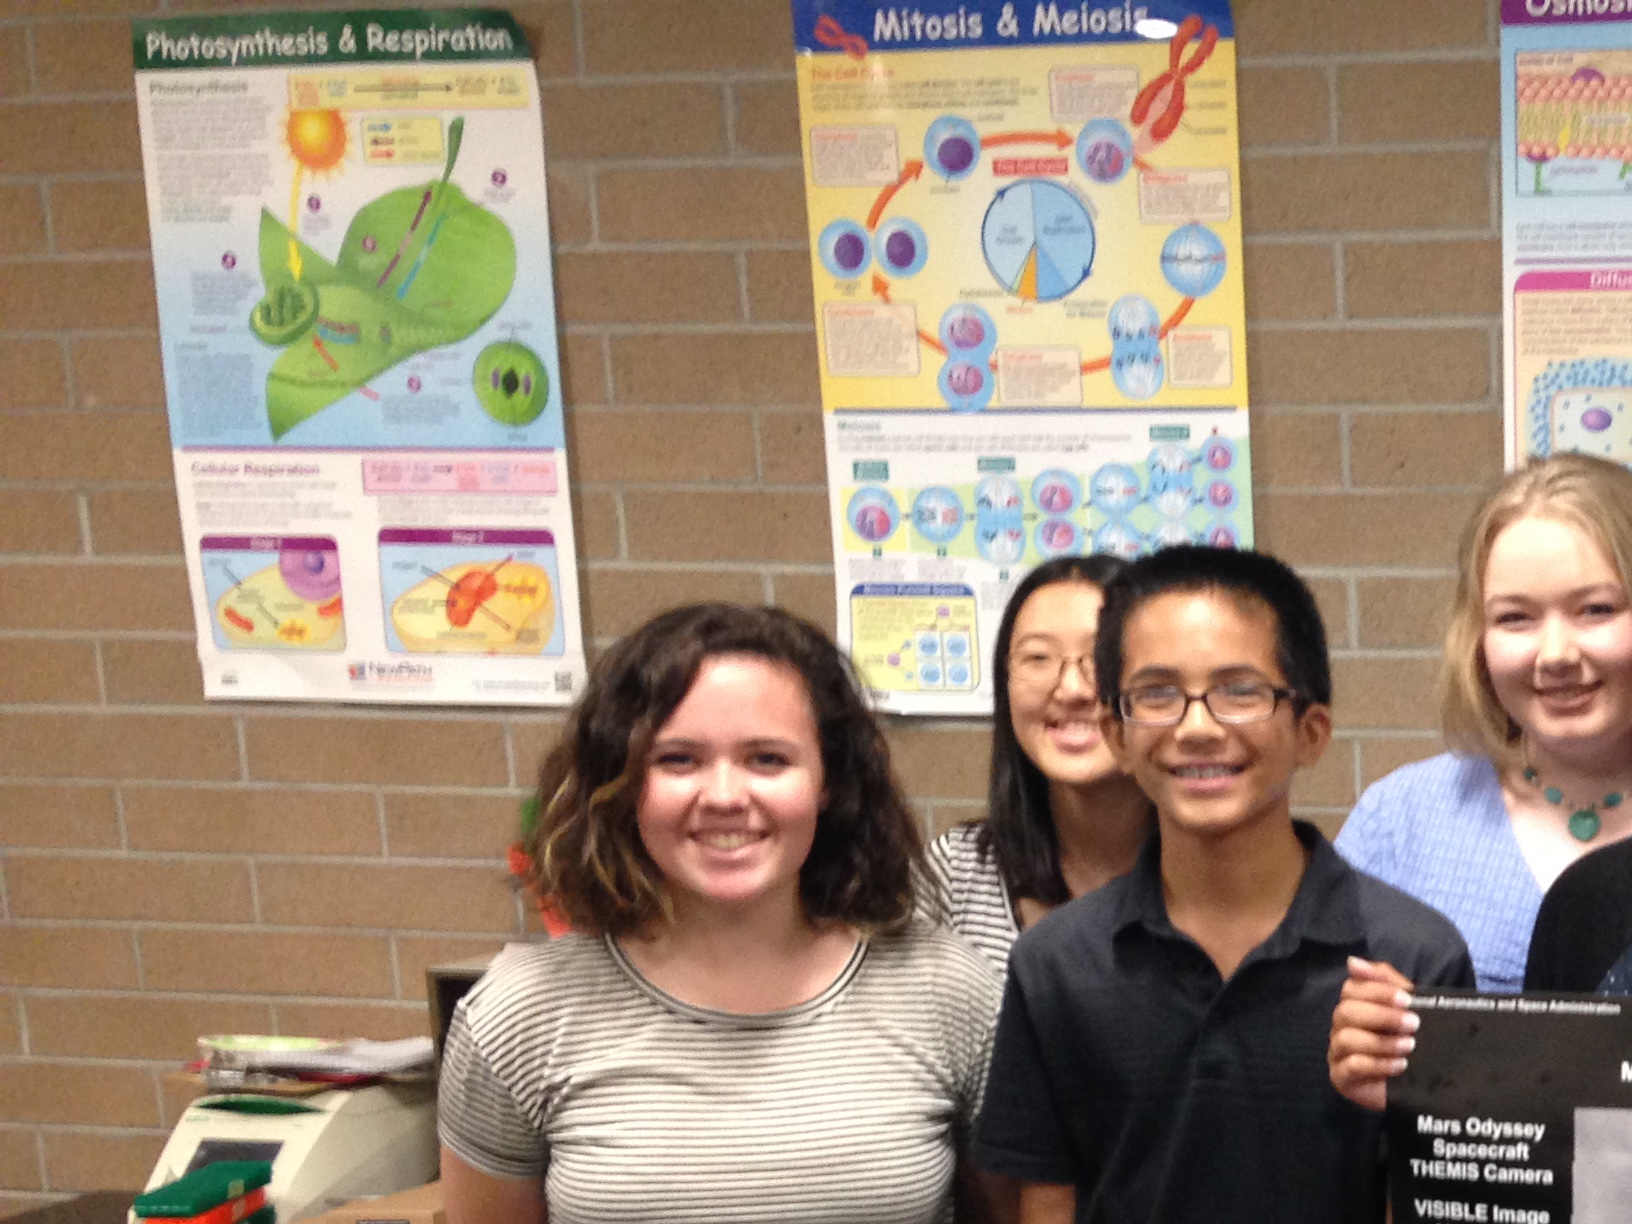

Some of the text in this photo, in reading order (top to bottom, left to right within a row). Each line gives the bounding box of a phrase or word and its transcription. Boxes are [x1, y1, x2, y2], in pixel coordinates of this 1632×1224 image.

[873, 7, 984, 41] Mitosis
[997, 3, 1019, 38] &
[145, 22, 515, 67] Photosynthesis & Respiration
[1498, 997, 1516, 1012] and
[1518, 997, 1548, 1014] Space
[1549, 998, 1622, 1016] Administration
[1417, 1114, 1546, 1143] Mars Odyssey
[1432, 1137, 1531, 1163] Spacecraft
[1410, 1158, 1555, 1186] THEMIS Camera
[1413, 1198, 1488, 1223] VISIBLE
